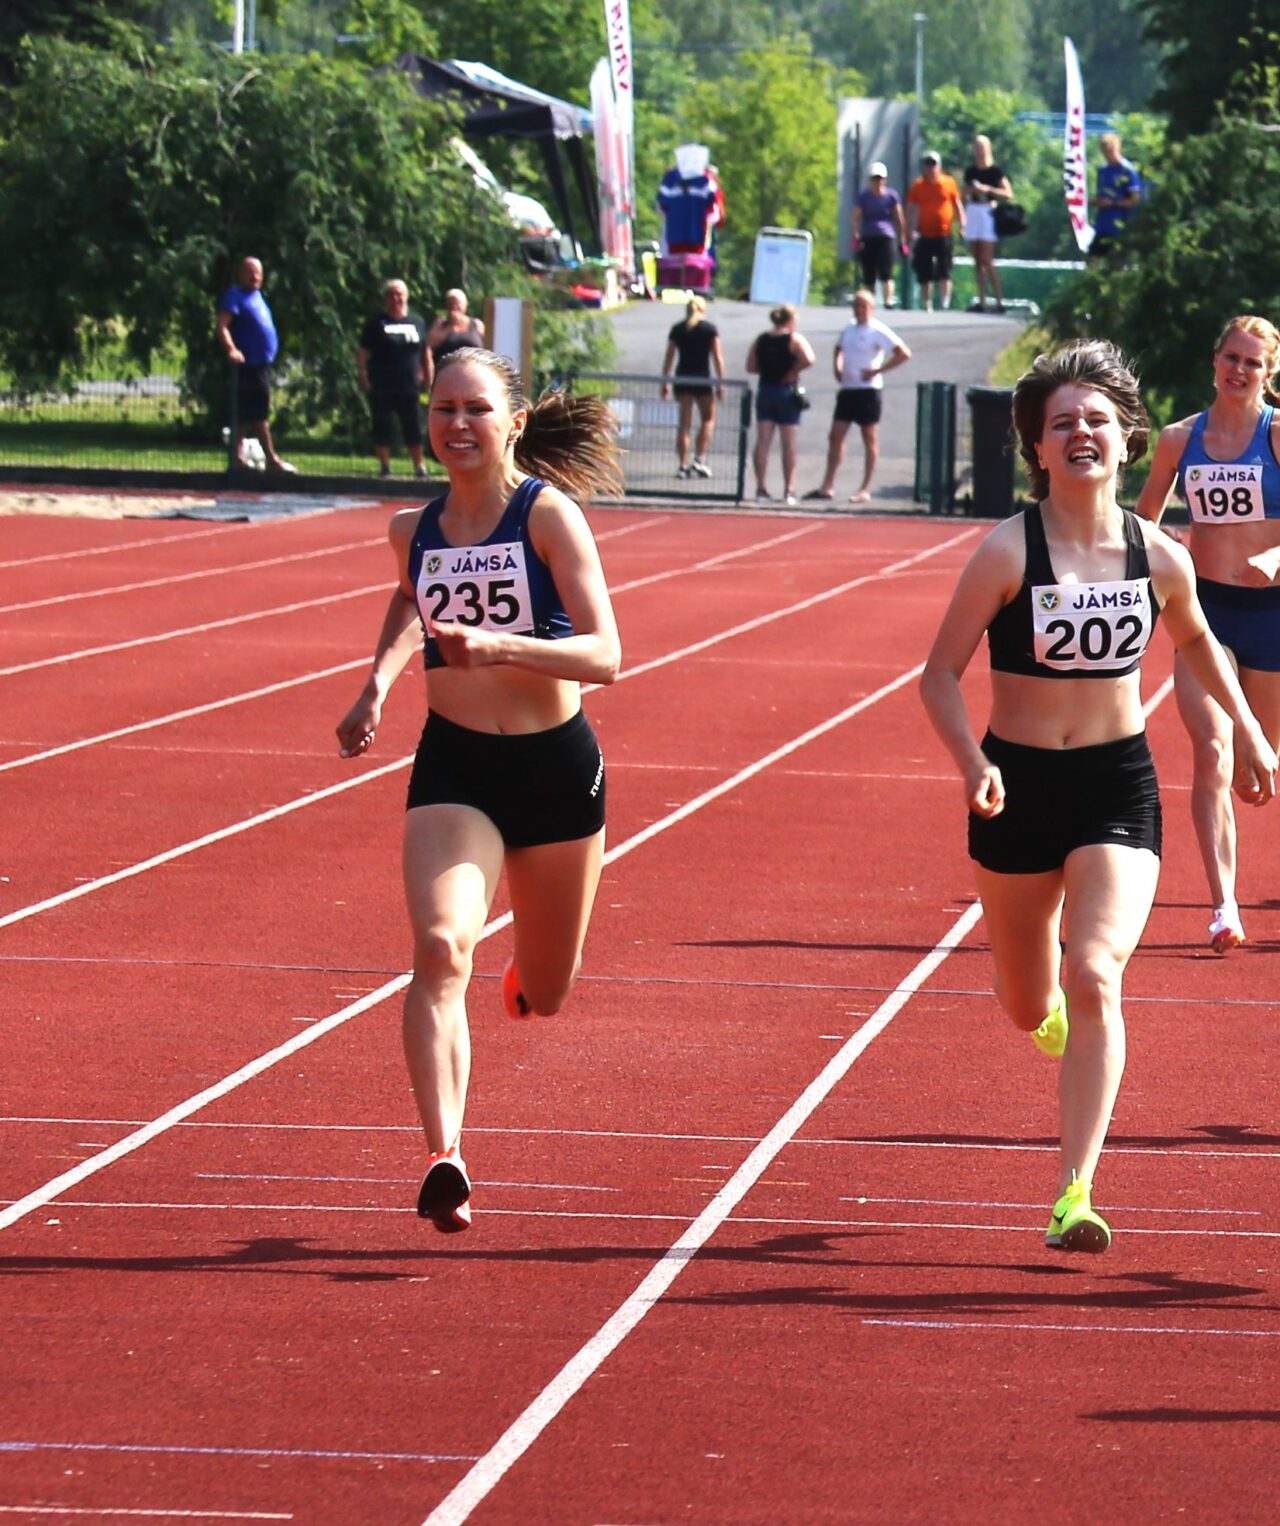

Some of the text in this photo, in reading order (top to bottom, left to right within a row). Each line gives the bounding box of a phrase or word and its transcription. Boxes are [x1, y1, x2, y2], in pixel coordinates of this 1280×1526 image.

[1194, 487, 1254, 517] 198
[425, 579, 520, 627] 235
[1045, 615, 1143, 661] 202
